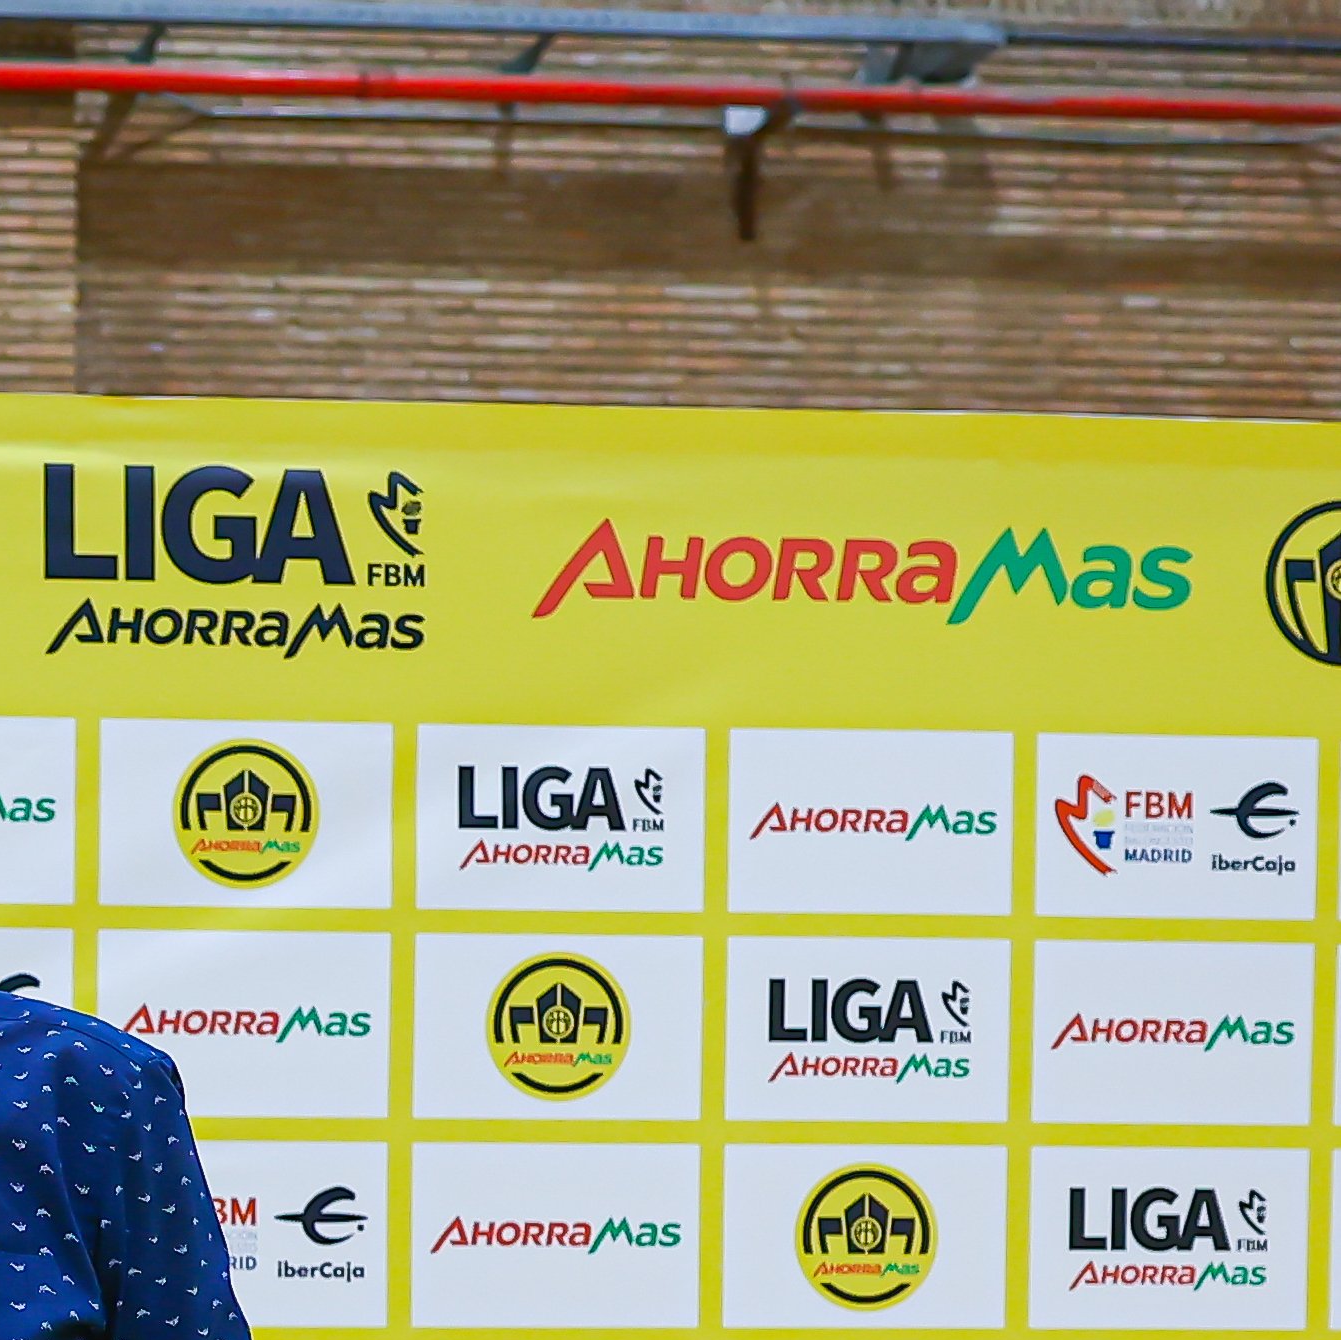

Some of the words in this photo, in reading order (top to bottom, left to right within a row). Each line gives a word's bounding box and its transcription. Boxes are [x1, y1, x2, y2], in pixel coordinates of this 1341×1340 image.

[40, 457, 357, 587] LIGA
[366, 562, 426, 588] FBM
[457, 764, 628, 833] LIGA
[1124, 789, 1194, 821] FBM
[1123, 847, 1193, 864] MADRID
[767, 977, 935, 1045] LIGA
[1068, 1185, 1232, 1253] LIGA
